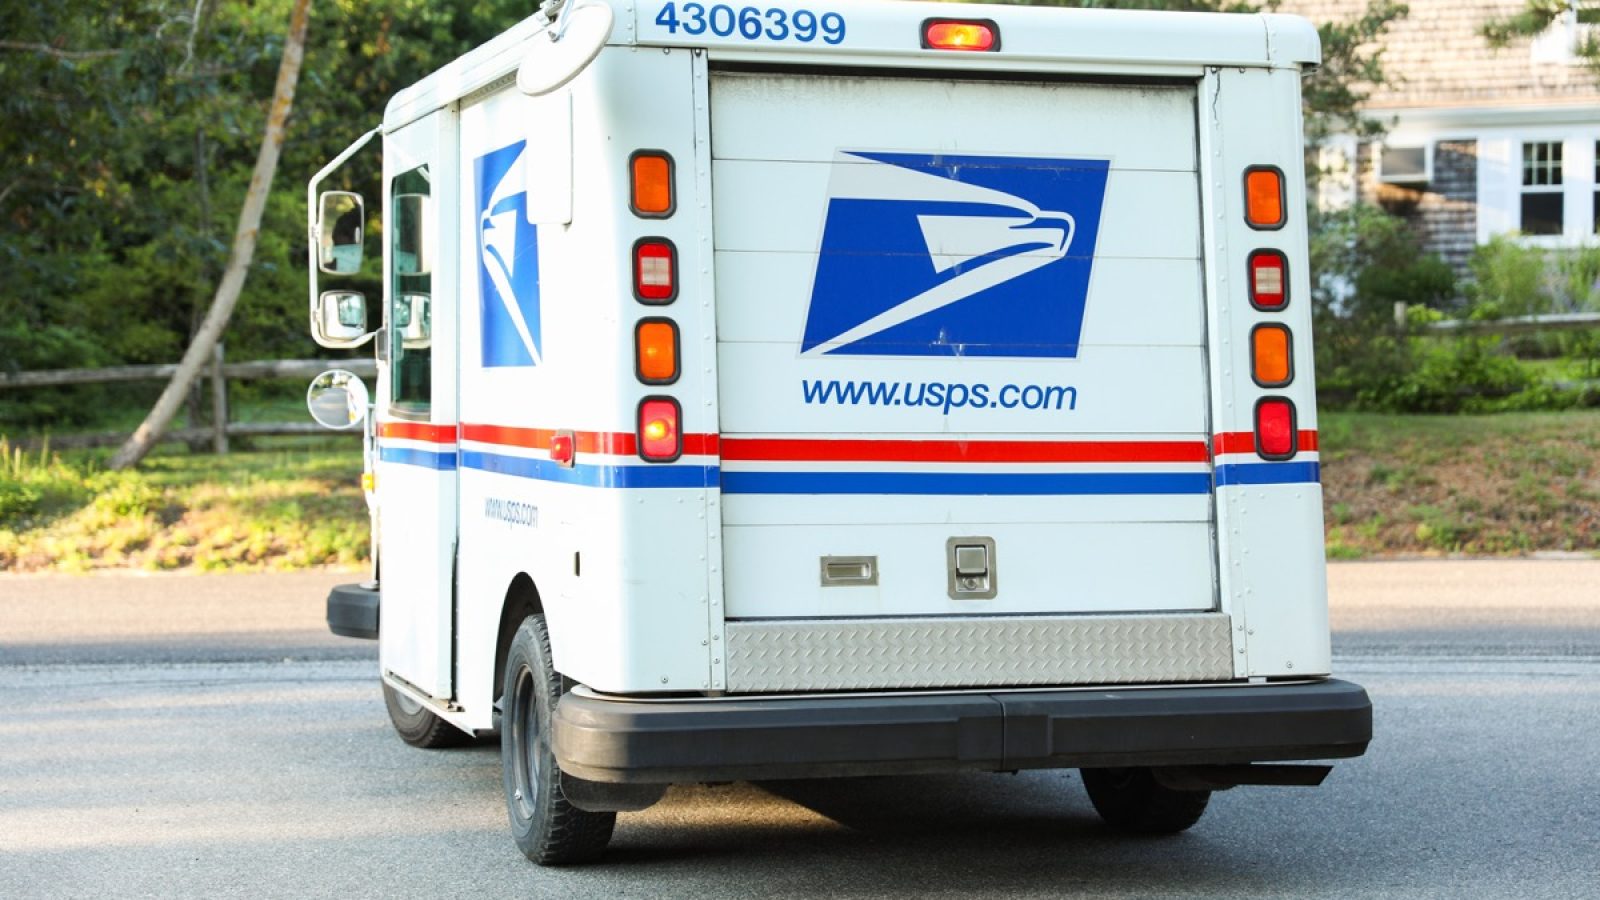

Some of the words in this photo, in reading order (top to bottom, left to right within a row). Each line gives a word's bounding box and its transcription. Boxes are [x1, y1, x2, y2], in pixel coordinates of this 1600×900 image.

[655, 2, 846, 44] 4306399
[802, 379, 1077, 415] www.usps.com
[485, 497, 538, 529] www.usps.com
